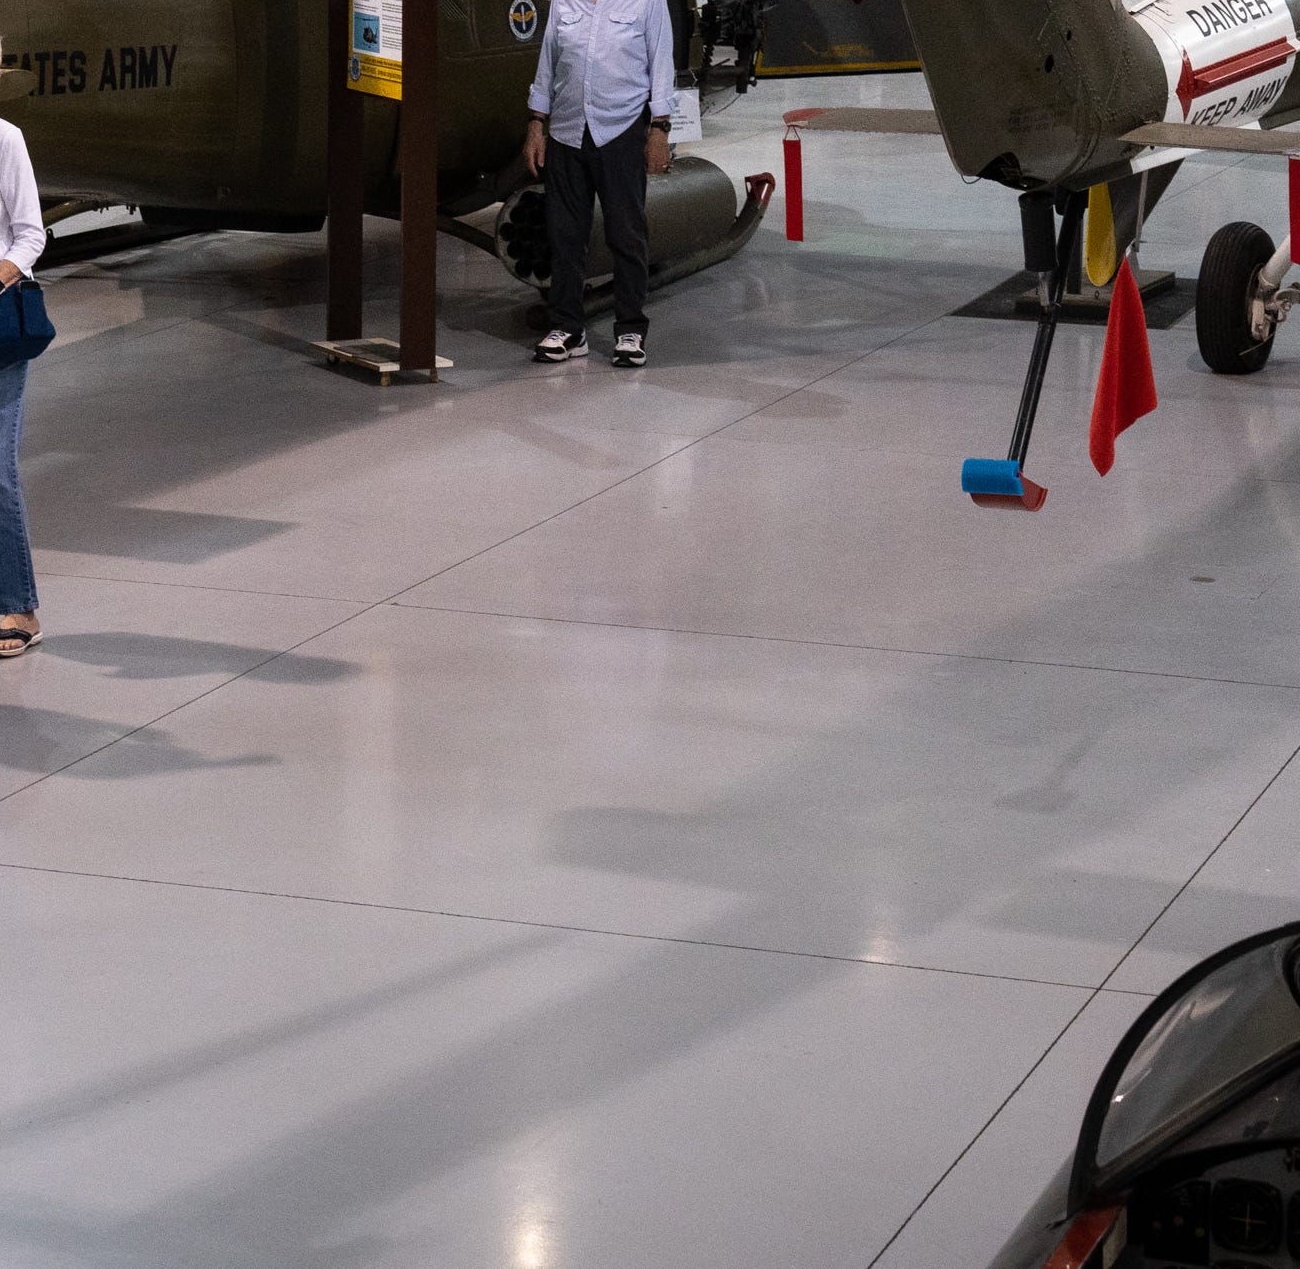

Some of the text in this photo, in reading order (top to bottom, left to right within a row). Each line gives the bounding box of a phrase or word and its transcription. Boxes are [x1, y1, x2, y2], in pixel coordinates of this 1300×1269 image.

[99, 44, 178, 92] ARMY
[1190, 76, 1287, 126] KEEP AWAY
